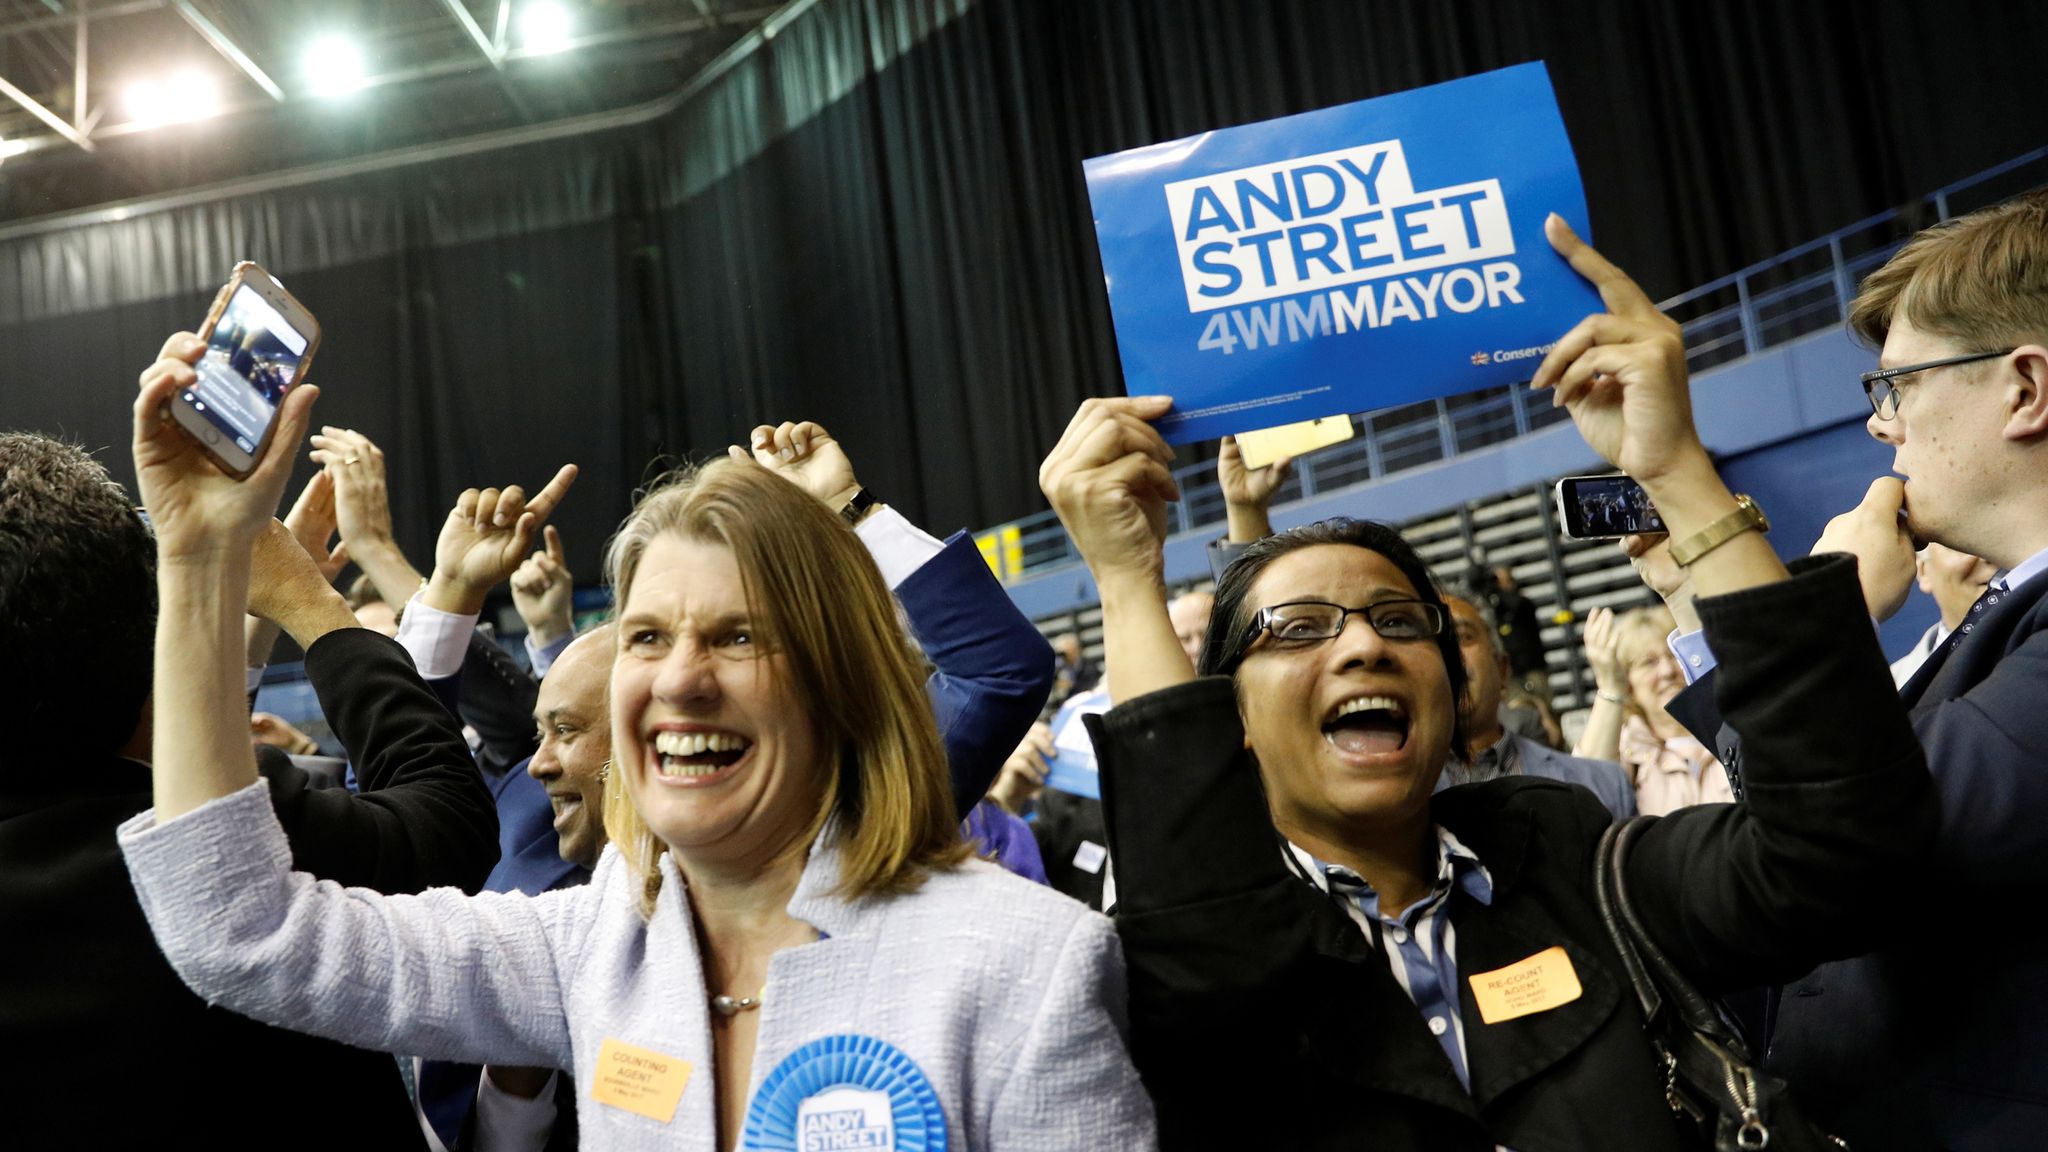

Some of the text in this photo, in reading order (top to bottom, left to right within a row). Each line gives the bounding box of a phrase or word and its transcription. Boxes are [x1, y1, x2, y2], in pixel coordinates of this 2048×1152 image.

[1185, 151, 1388, 242] ANDY
[1192, 190, 1489, 298] STREET
[1487, 965, 1544, 990] RE-COUNT
[1504, 979, 1541, 997] AGENT
[612, 1051, 668, 1074] COUNTING
[616, 1067, 653, 1083] AGENT
[806, 1110, 863, 1131] ANDY
[806, 1127, 887, 1151] STREET
